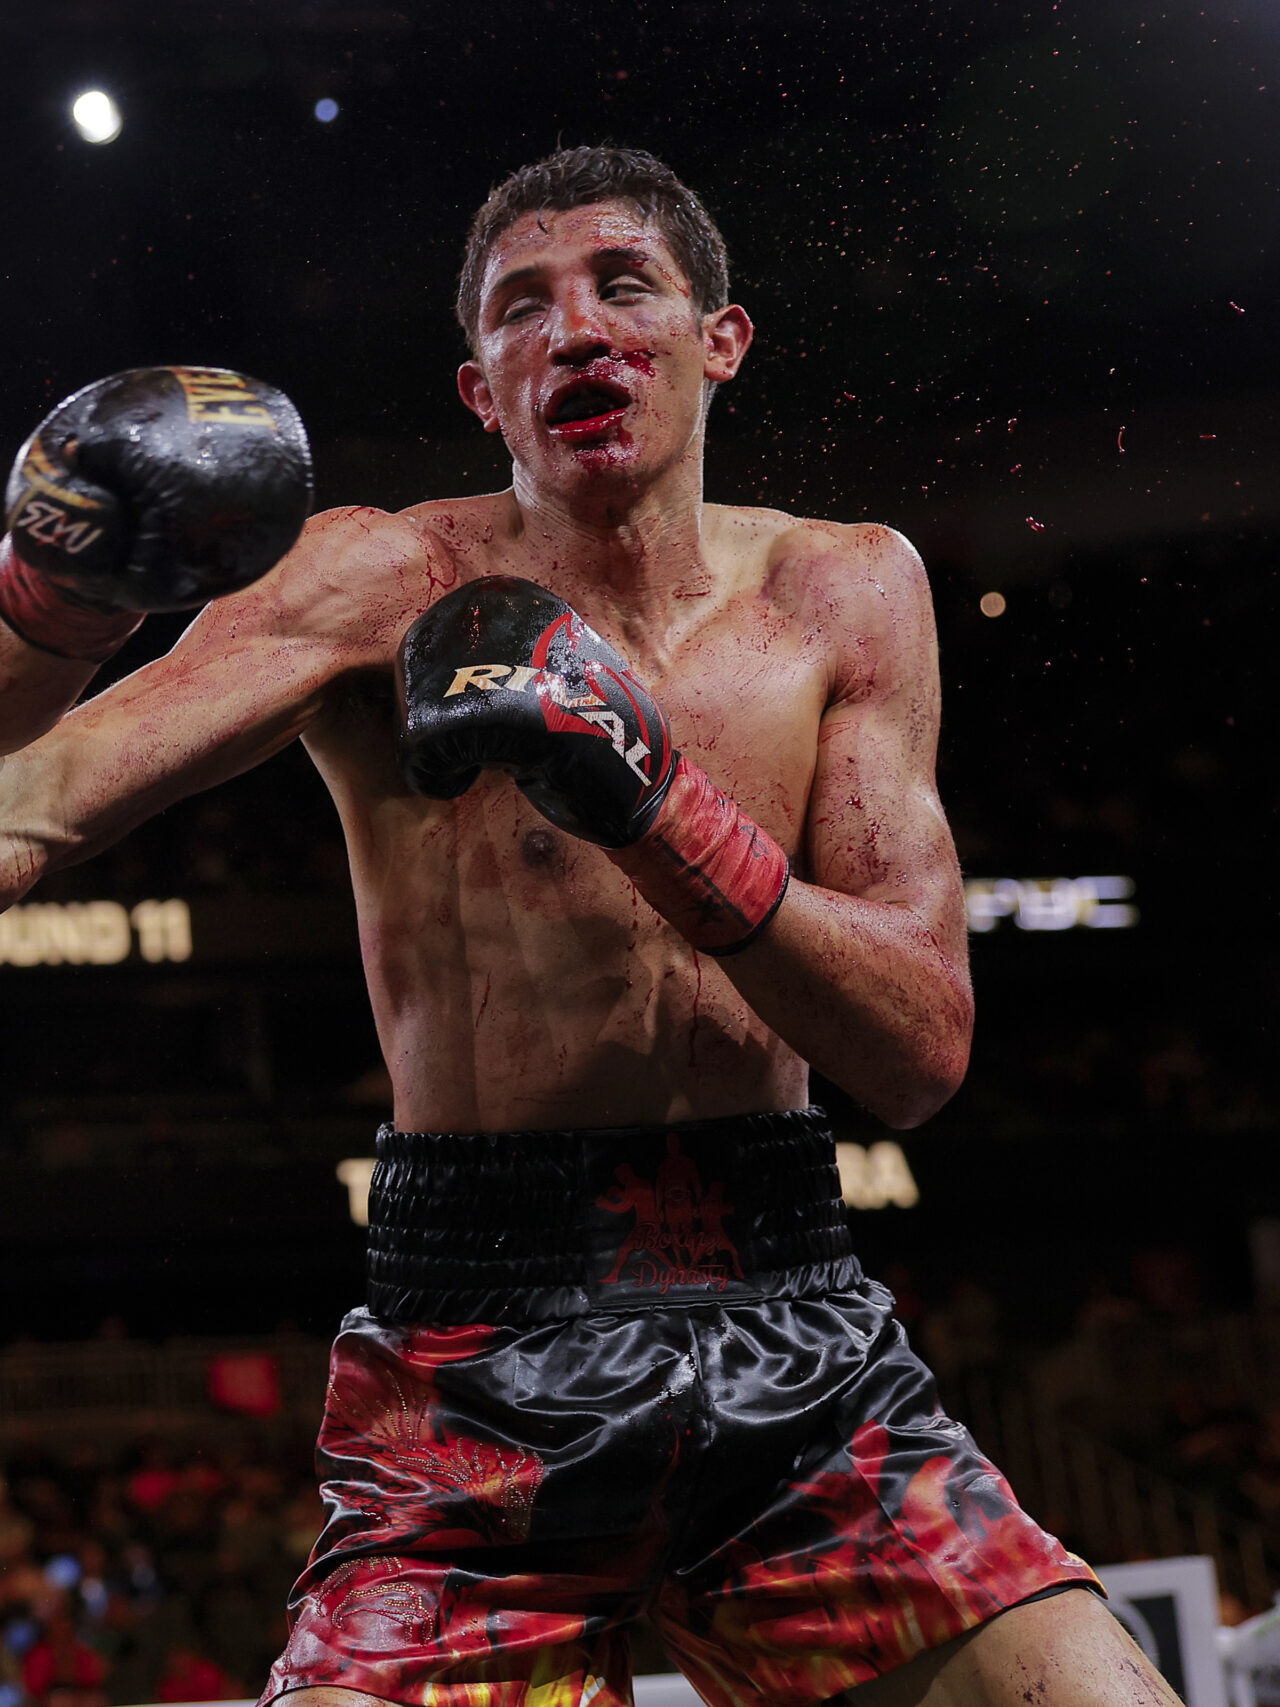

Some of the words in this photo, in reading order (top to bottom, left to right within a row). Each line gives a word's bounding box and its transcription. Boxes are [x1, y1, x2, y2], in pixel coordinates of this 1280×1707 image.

[443, 663, 653, 788] RIVAL
[633, 1221, 722, 1257] Boxing
[631, 1257, 732, 1296] Dynasty
